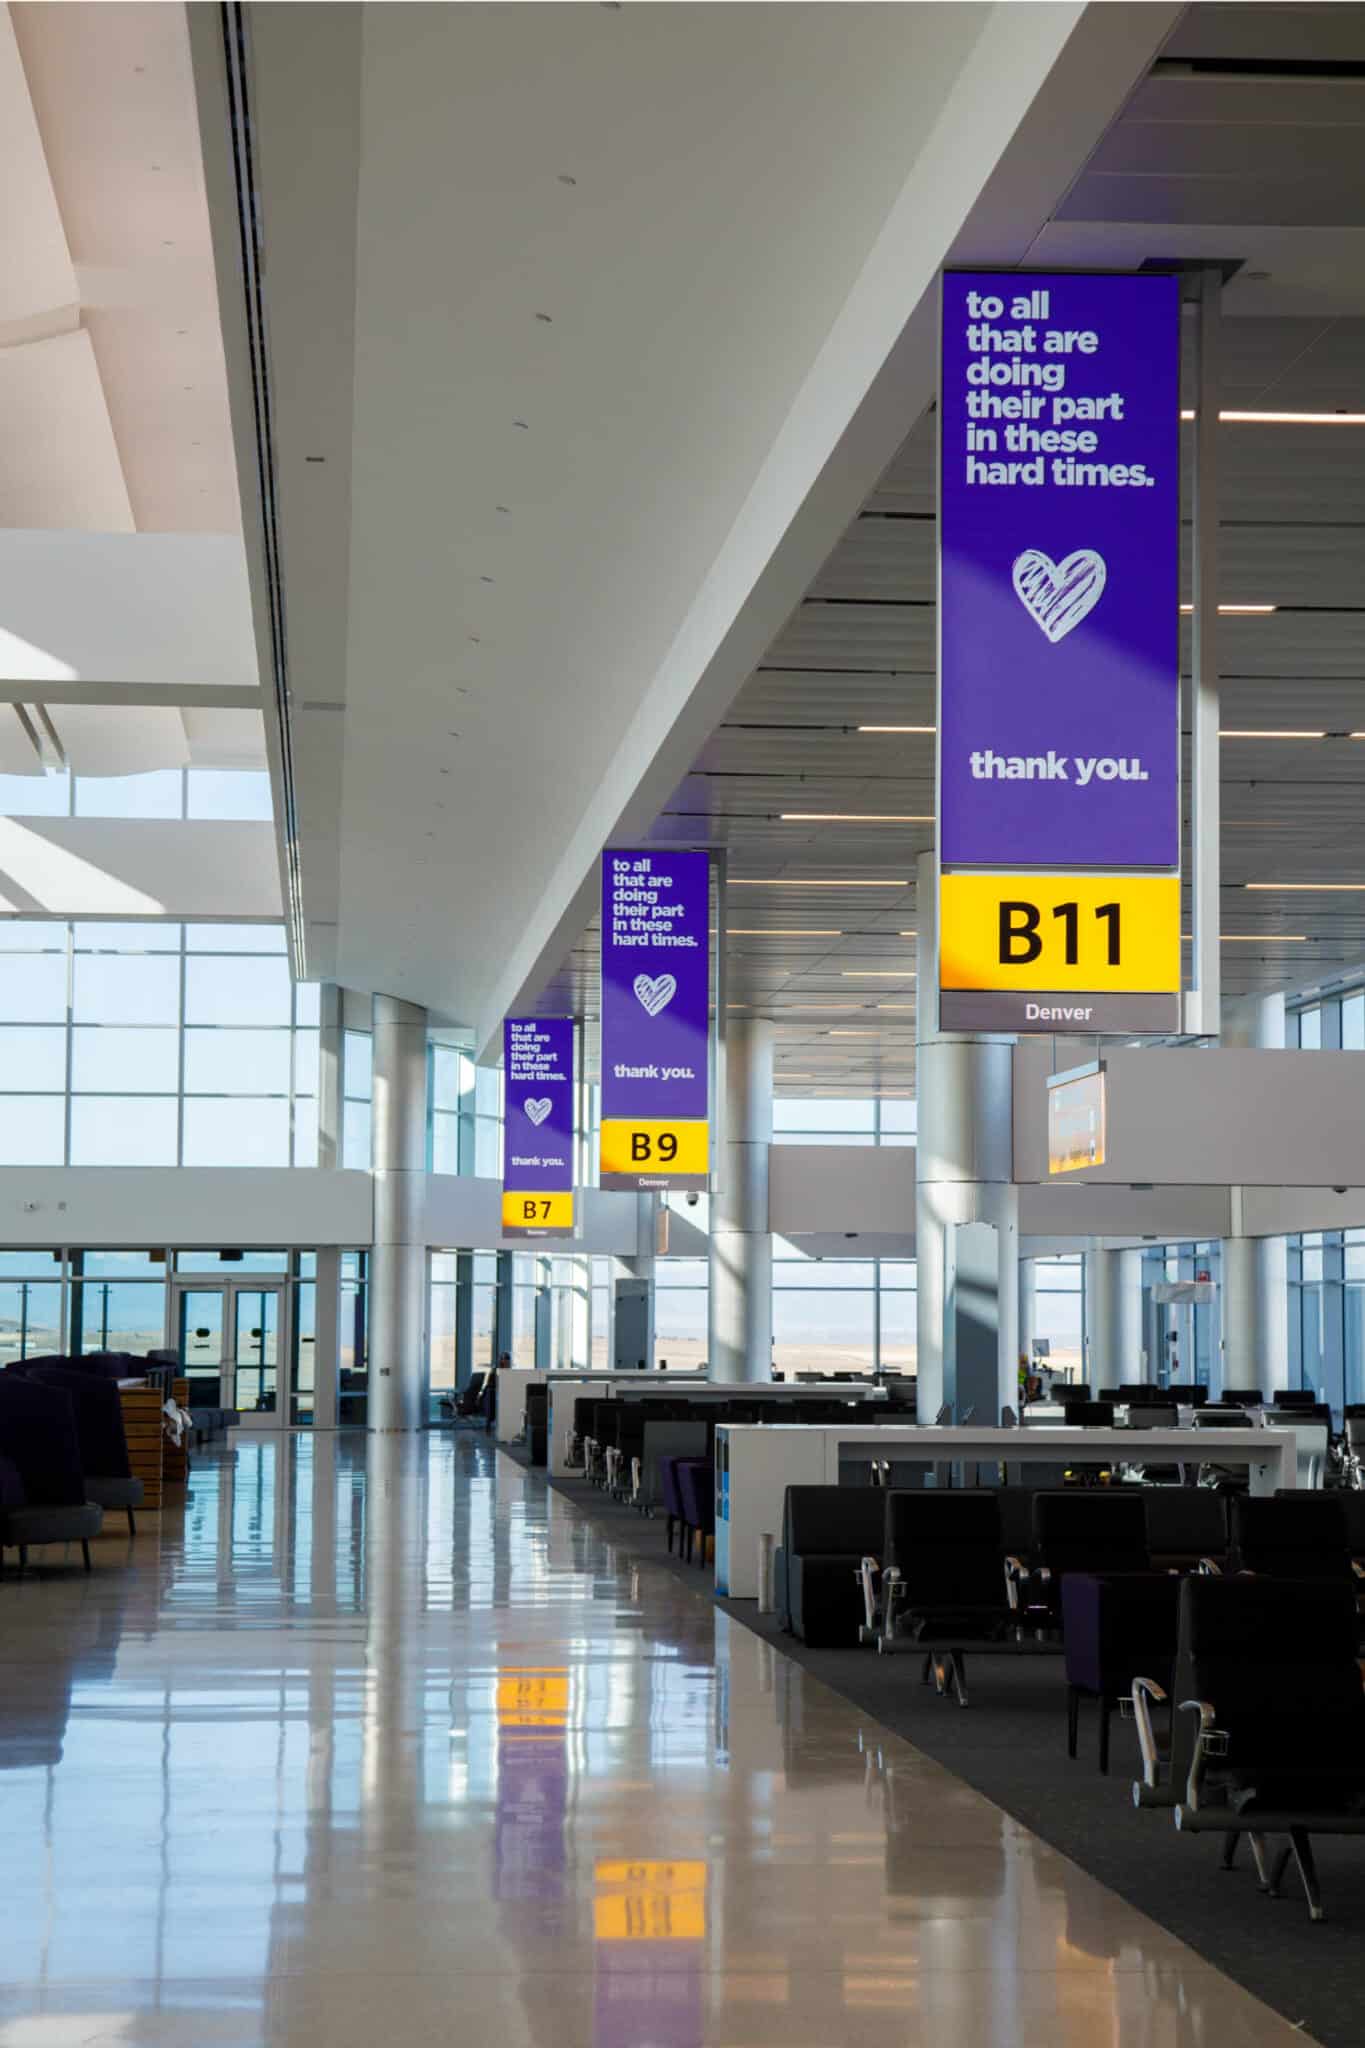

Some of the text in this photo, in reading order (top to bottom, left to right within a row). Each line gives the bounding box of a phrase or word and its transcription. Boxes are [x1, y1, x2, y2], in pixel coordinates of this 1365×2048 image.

[966, 290, 1050, 320] to all
[966, 324, 1099, 354] that are
[966, 357, 1065, 391] doing
[966, 390, 1125, 424] their part
[966, 423, 1099, 453] in these
[966, 456, 1155, 487] hard times.
[969, 750, 1149, 786] thank you.
[613, 859, 652, 873] to all
[612, 873, 673, 887] that are
[613, 888, 658, 904] doing
[613, 903, 685, 919] their part
[613, 918, 673, 932] in these
[998, 901, 1121, 965] B11
[612, 933, 699, 947] hard times.
[1025, 1003, 1093, 1021] Denver
[613, 1064, 695, 1080] thank you.
[631, 1132, 678, 1162] B9
[523, 1200, 552, 1219] B7
